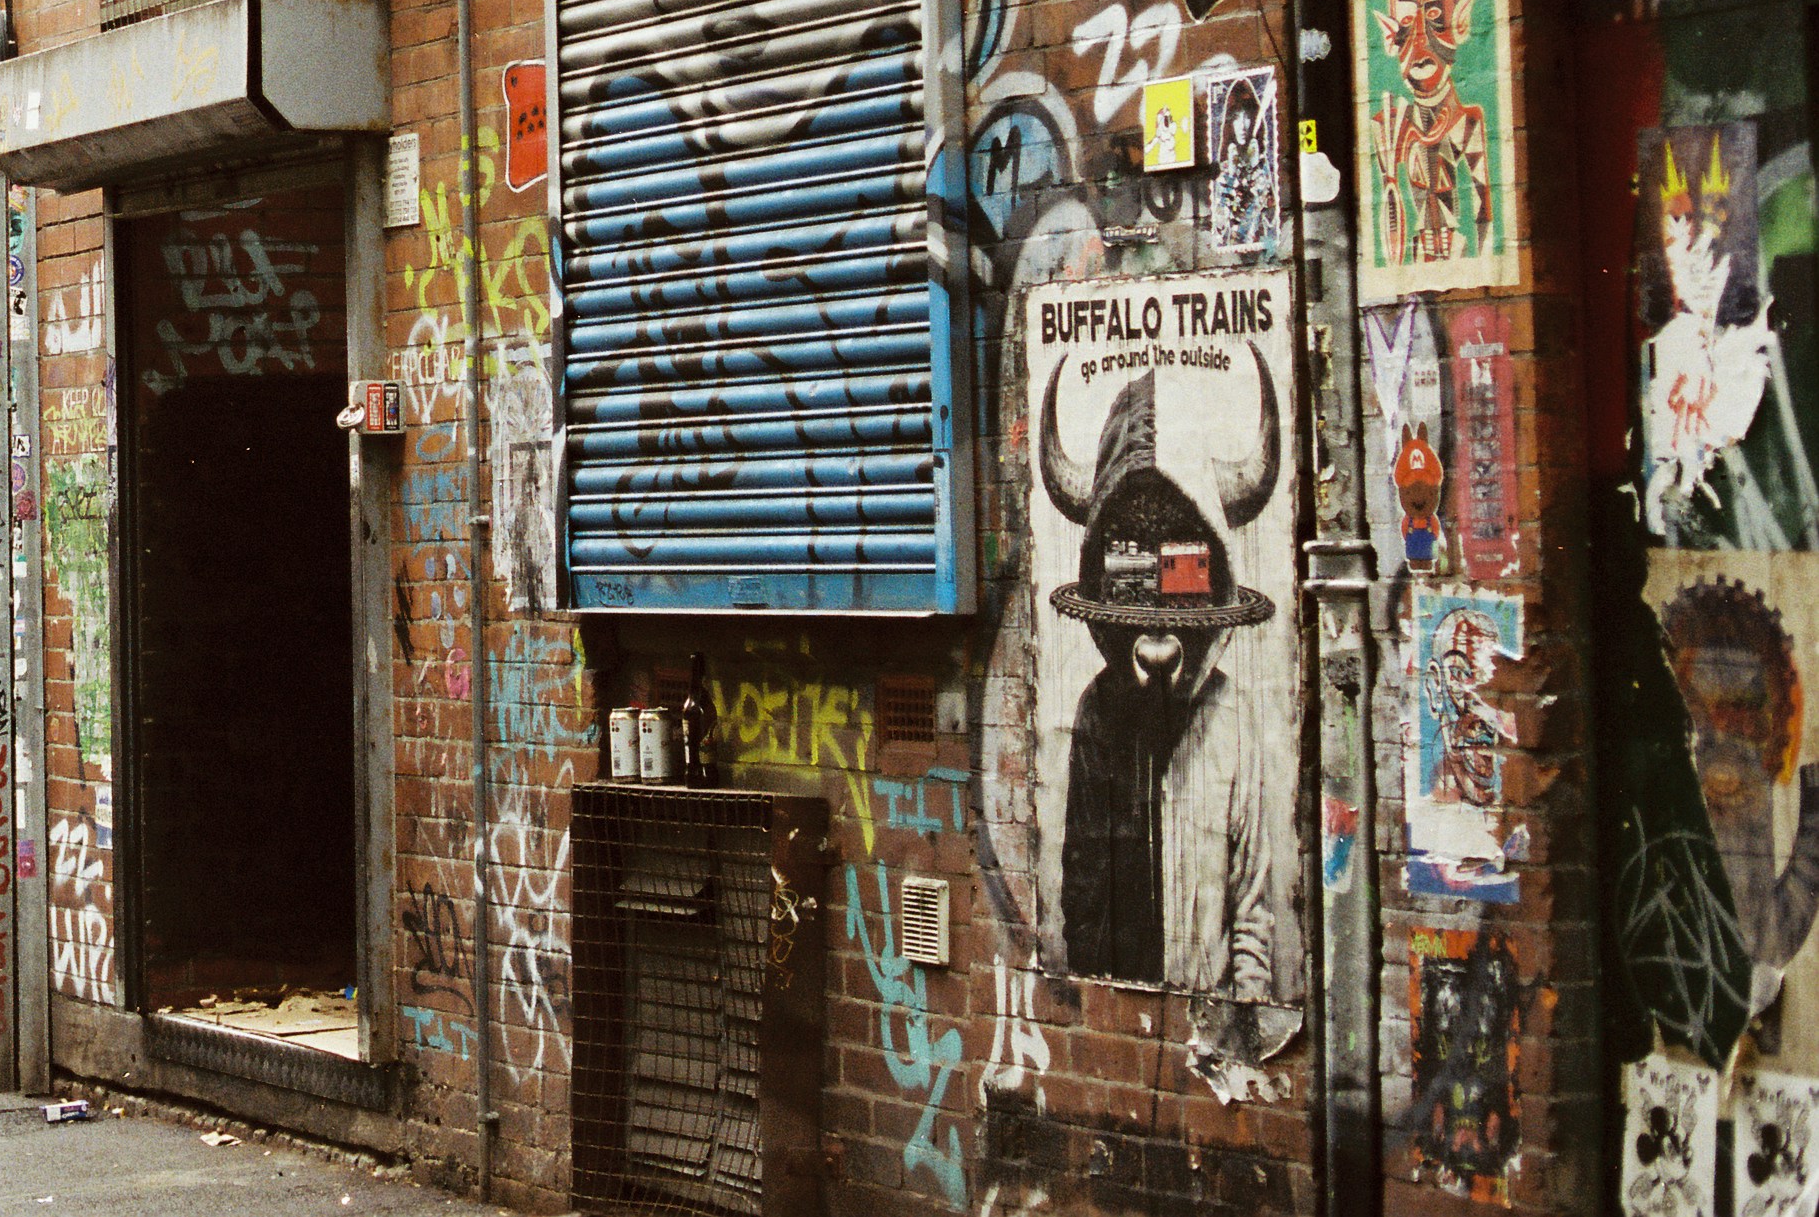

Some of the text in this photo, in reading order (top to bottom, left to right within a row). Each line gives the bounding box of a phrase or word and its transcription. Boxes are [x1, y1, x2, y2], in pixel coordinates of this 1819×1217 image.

[1041, 288, 1273, 344] BUFFALO TRAINS
[1081, 344, 1231, 383] go around the outside
